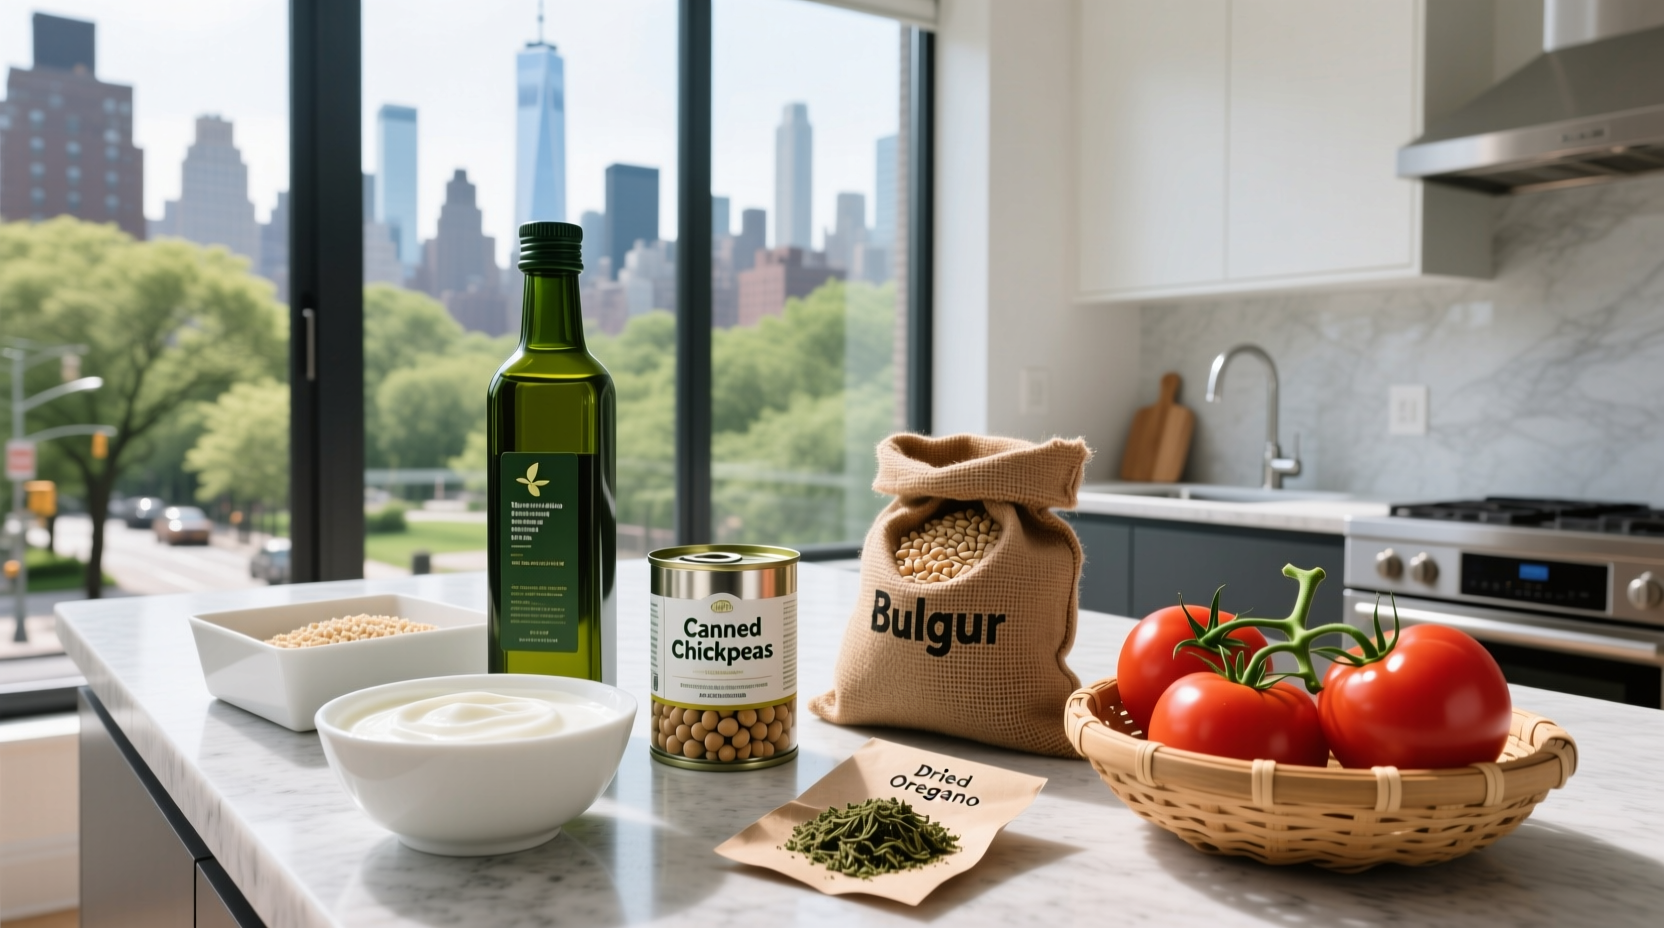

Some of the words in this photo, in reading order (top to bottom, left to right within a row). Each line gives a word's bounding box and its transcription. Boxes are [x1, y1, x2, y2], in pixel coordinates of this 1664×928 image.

[684, 616, 761, 638] Canned
[871, 589, 1006, 657] Bulgur
[672, 639, 773, 666] Chickpeas
[914, 764, 973, 788] Dried
[890, 774, 980, 807] Oregano
